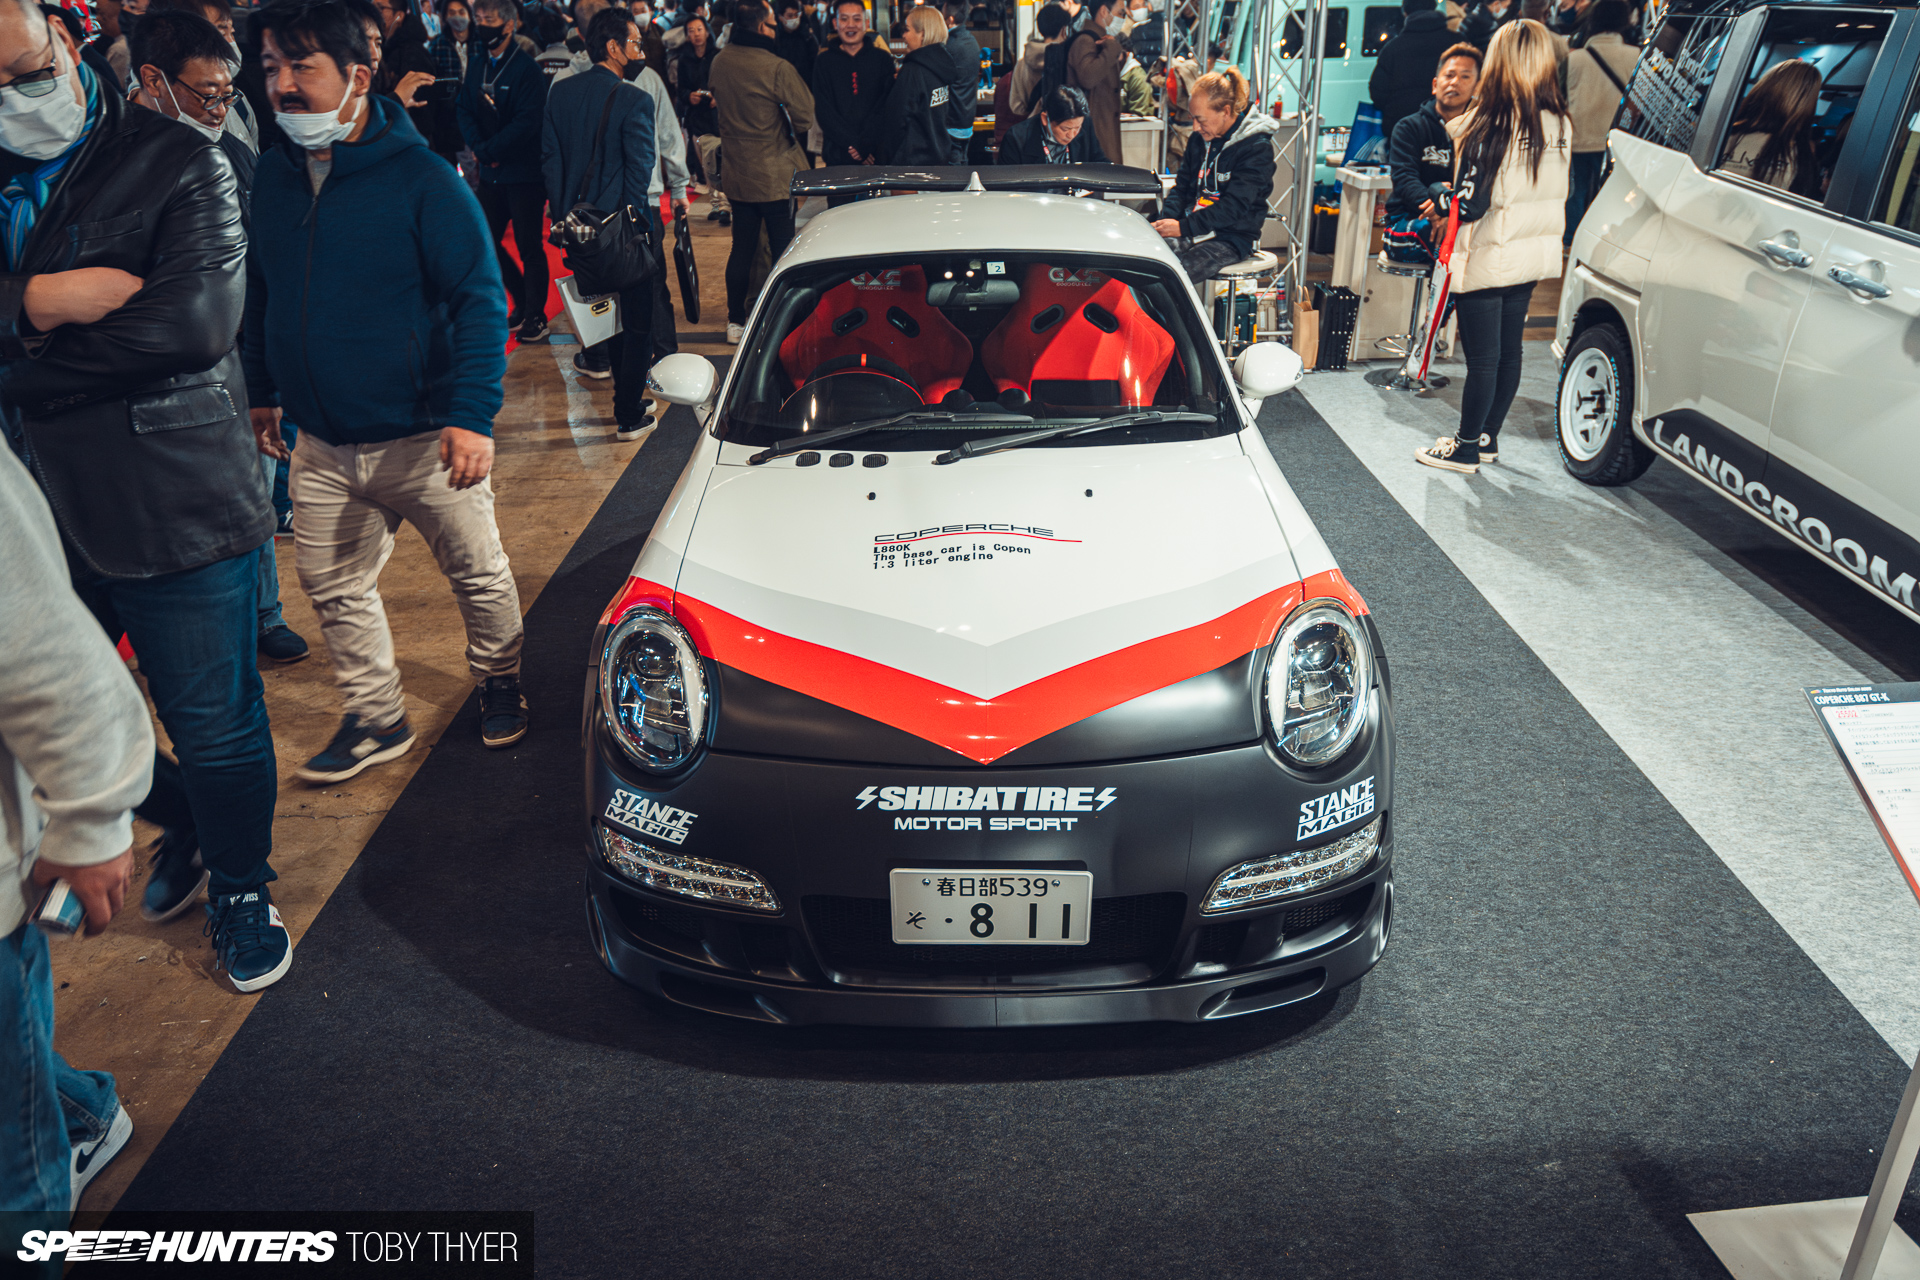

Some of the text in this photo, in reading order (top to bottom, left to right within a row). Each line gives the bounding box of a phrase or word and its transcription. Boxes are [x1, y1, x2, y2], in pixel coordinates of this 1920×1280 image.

[1653, 418, 1920, 610] LANDCROOM
[874, 523, 1054, 542] COPERCHE
[873, 543, 911, 554] L880K
[873, 543, 1031, 562] The base car is Copen
[873, 552, 994, 570] 1.3 liter engine
[1814, 694, 1855, 705] COPERCHE
[878, 786, 1096, 811] SHIBATIRE
[1299, 775, 1375, 824] STANCE
[610, 788, 698, 831] STANCE
[1297, 795, 1375, 841] MAGIC
[605, 804, 689, 845] MAGIC
[894, 817, 1078, 831] MOTOR SPORT
[905, 911, 926, 930] そ
